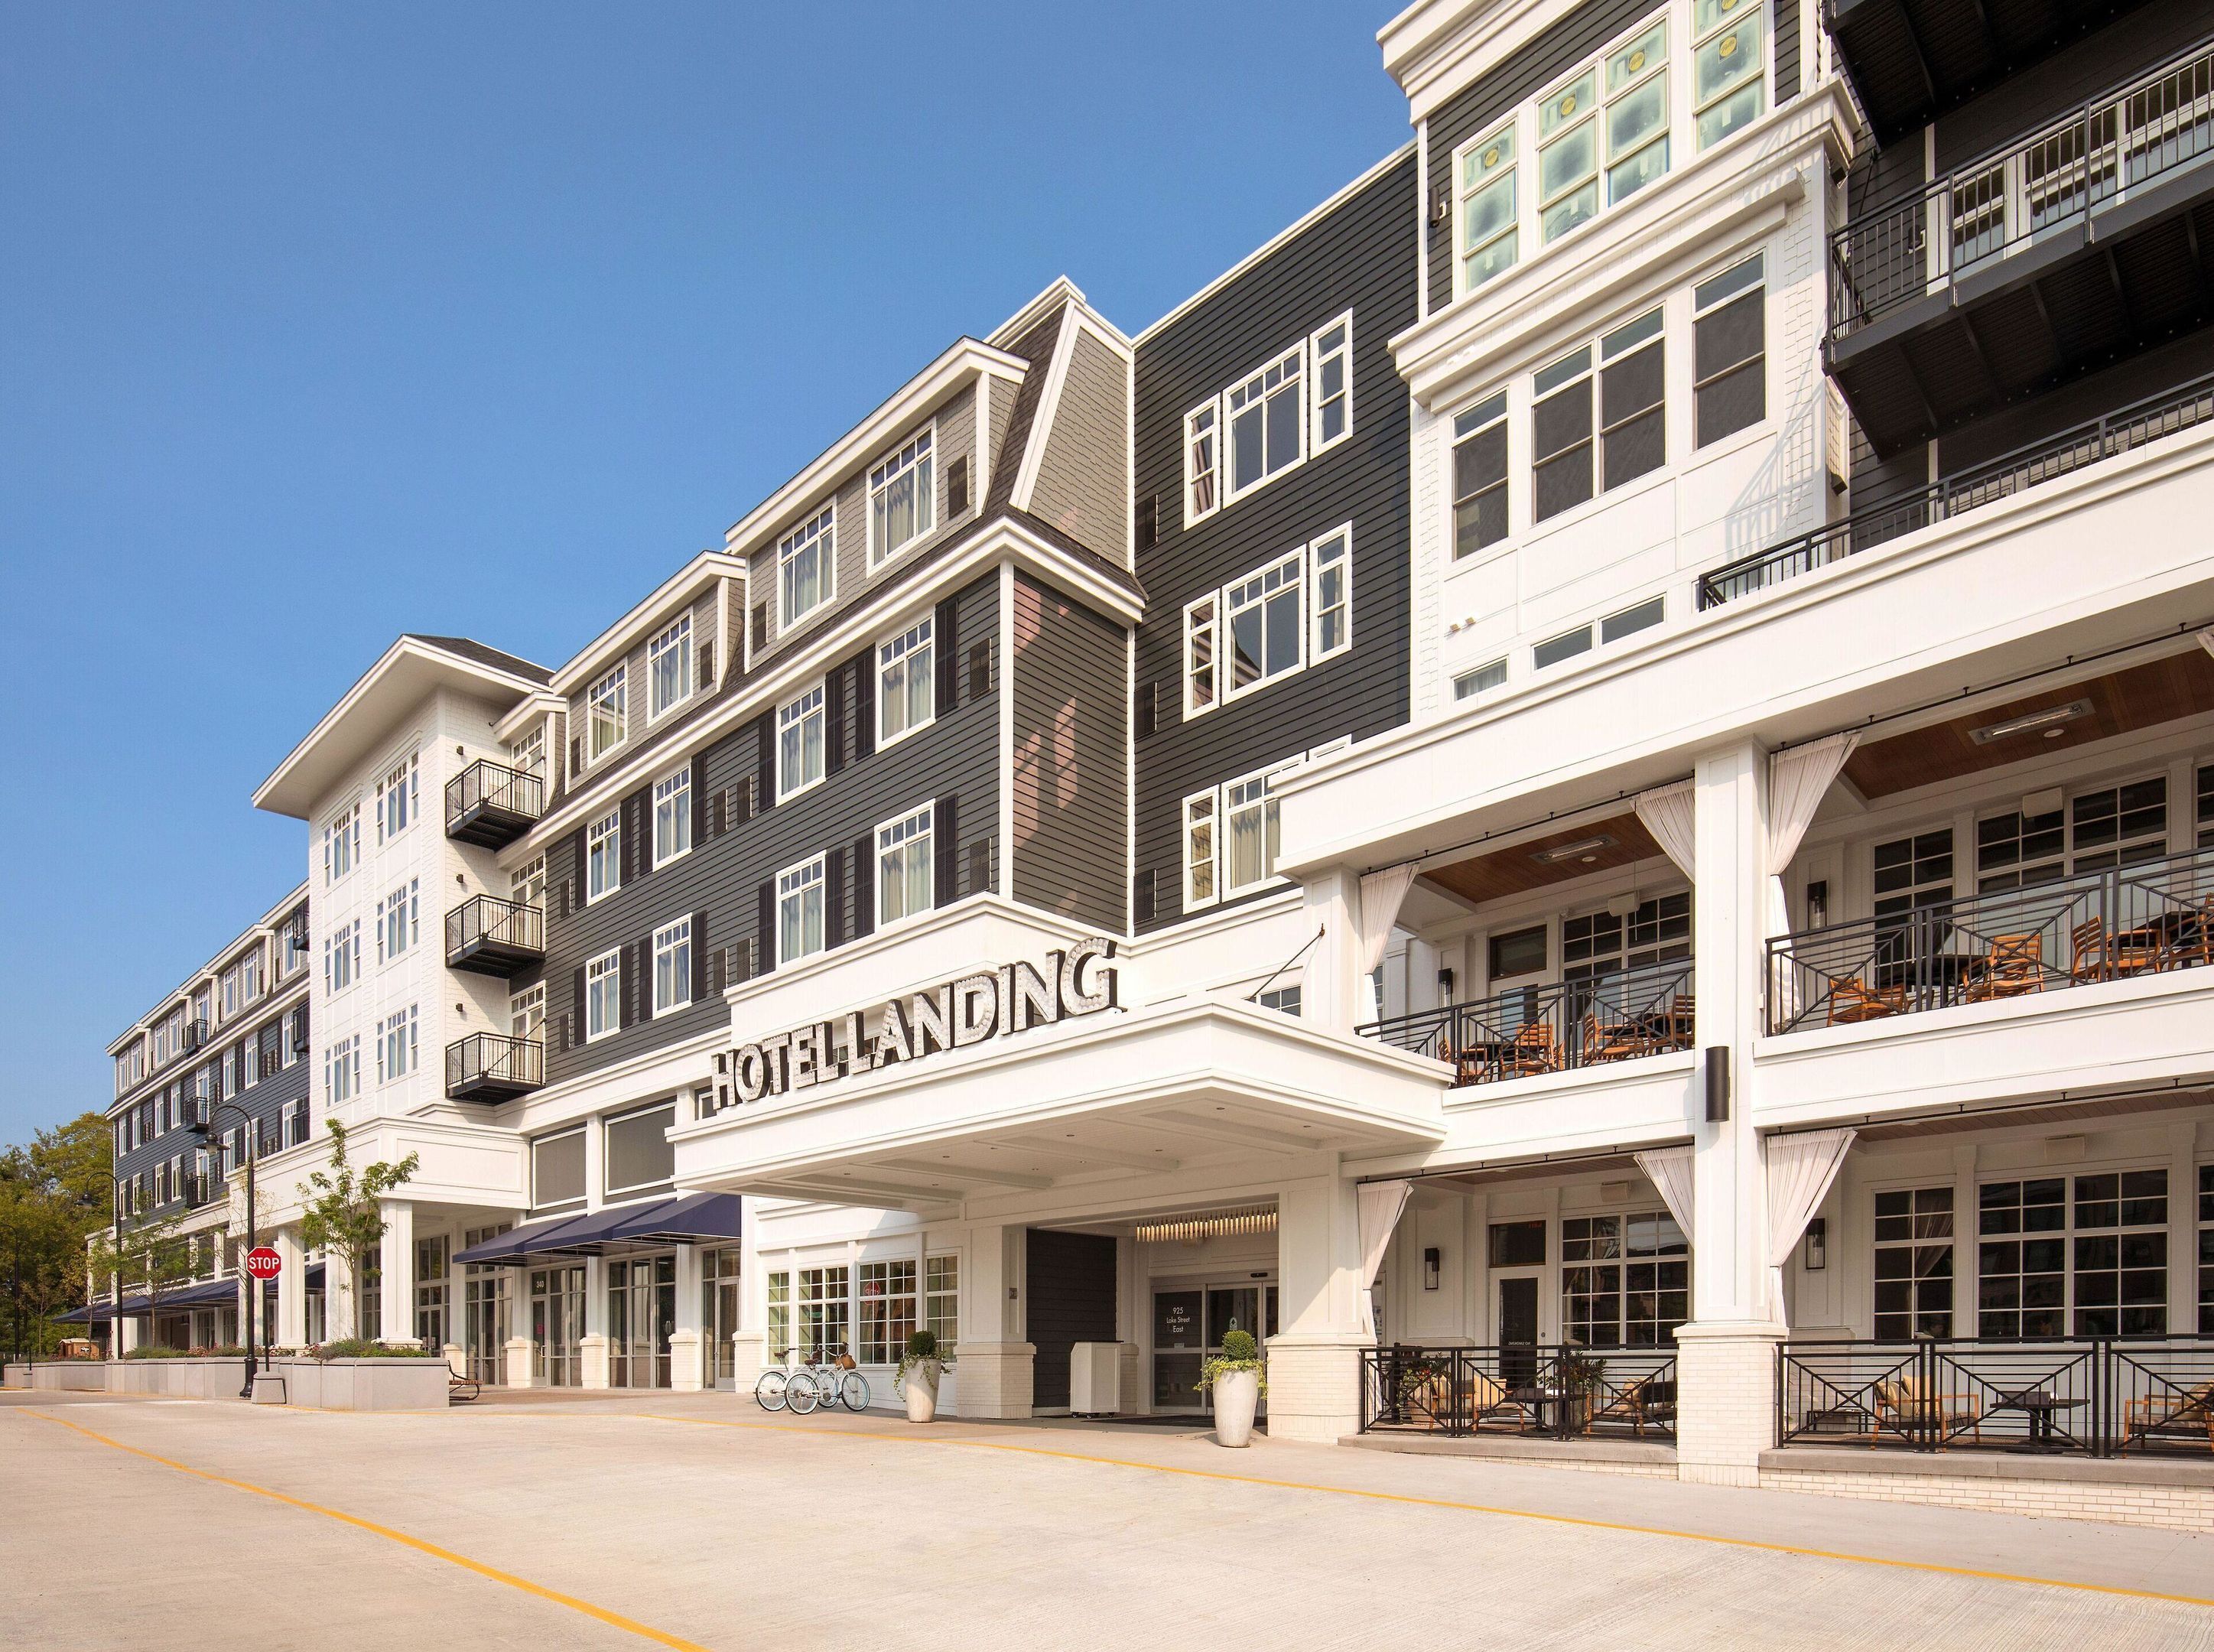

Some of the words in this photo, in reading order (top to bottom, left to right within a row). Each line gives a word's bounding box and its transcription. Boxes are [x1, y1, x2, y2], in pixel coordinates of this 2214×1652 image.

[711, 1020, 839, 1110] HOTEL
[846, 937, 1117, 1075] LANDING
[249, 1257, 280, 1270] STOP
